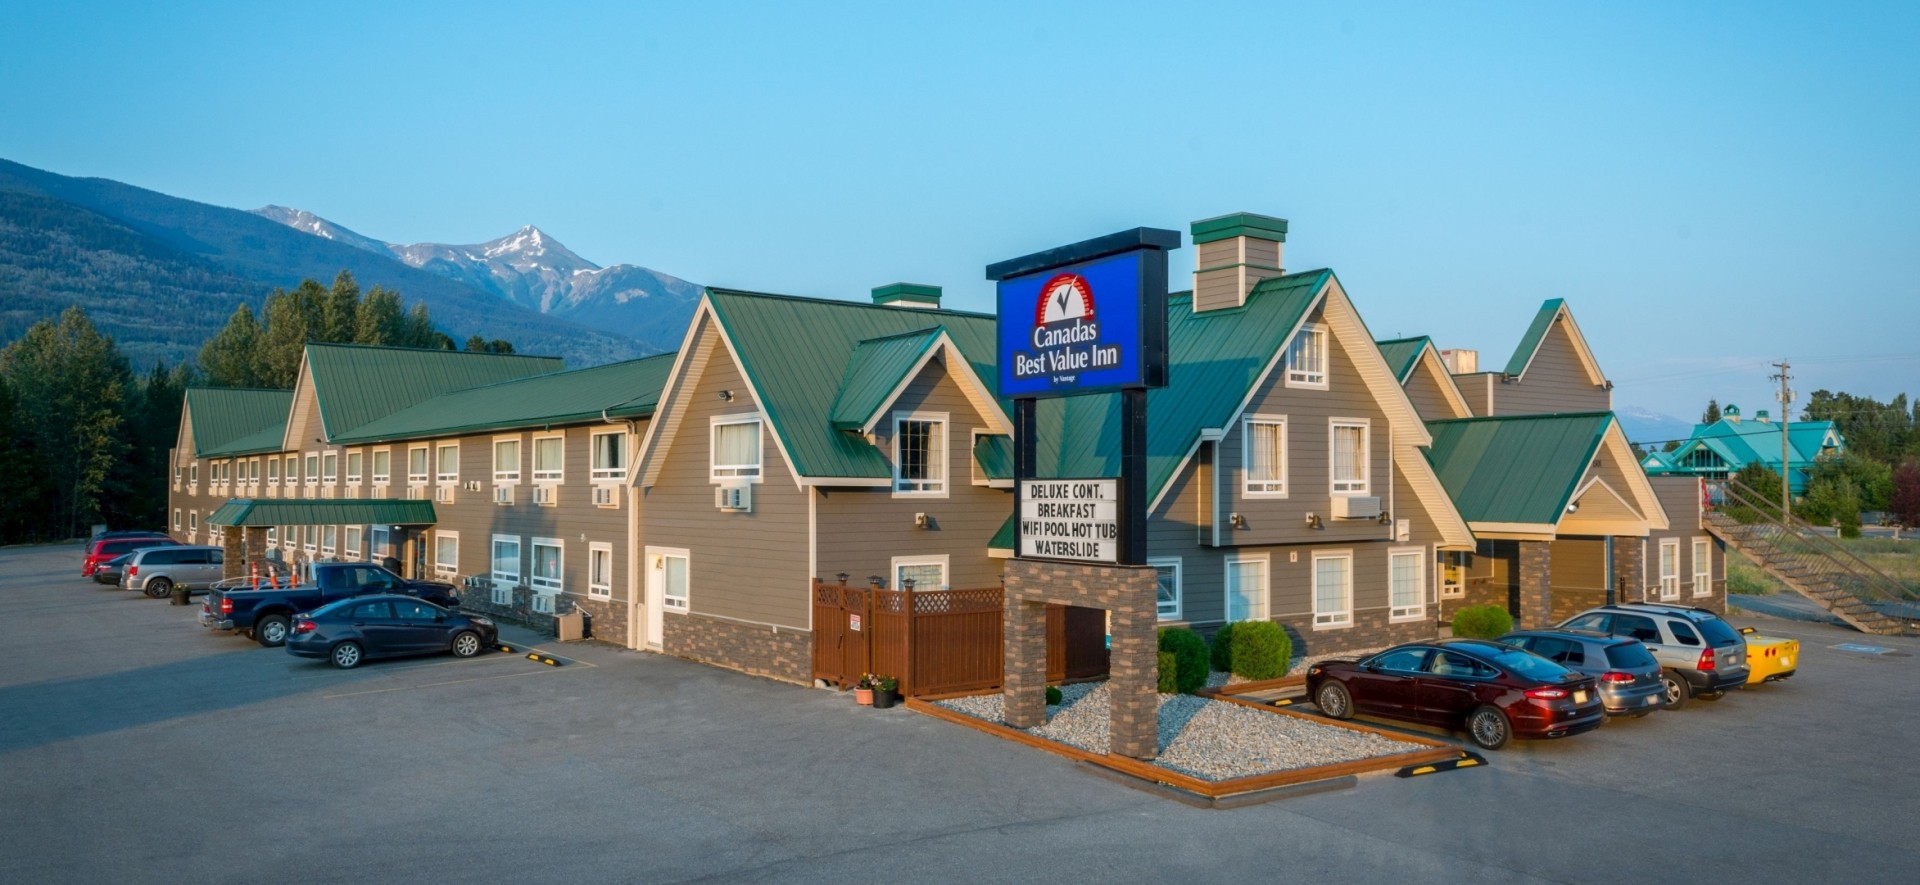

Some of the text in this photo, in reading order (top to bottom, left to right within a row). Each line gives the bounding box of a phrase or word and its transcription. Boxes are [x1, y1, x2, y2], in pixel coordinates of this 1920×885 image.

[1034, 318, 1096, 348] Canadas
[1016, 345, 1117, 376] Best Value Inn
[1053, 375, 1059, 384] by
[1031, 484, 1103, 499] DELUXE CONT.
[1038, 503, 1095, 518] BREAKFAST
[1022, 521, 1117, 539] WIFI POOL HOT TUB
[1035, 540, 1099, 558] WATERSLIDE
